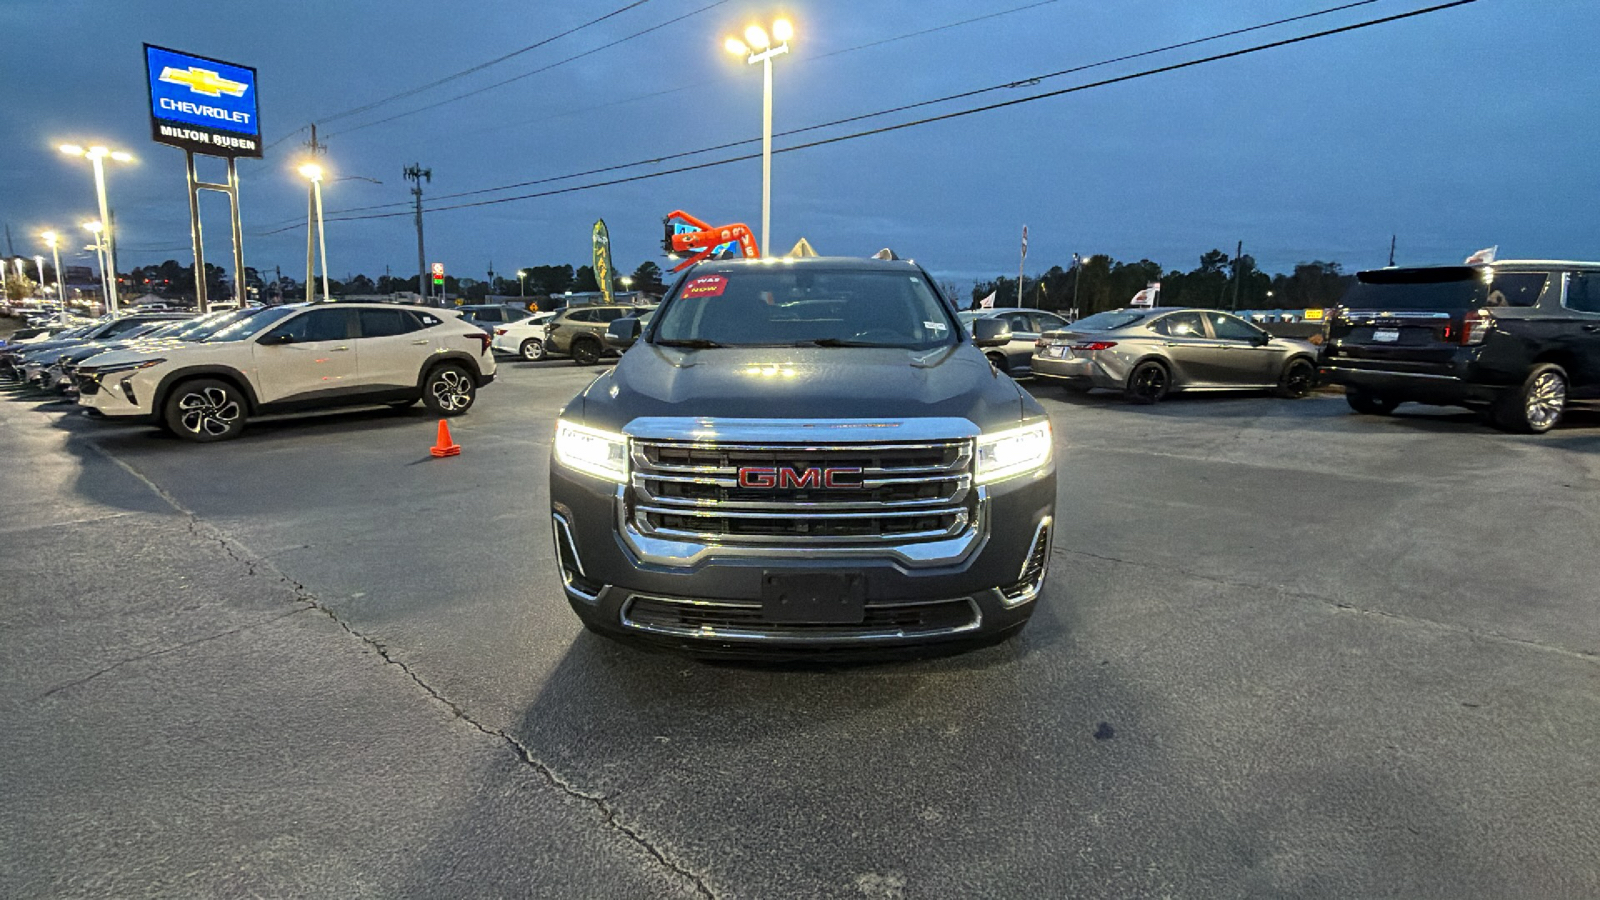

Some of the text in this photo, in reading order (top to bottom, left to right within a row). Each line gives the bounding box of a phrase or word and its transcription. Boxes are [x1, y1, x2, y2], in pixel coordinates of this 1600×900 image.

[160, 98, 250, 123] CHEVROLET
[160, 125, 209, 143] MILTON
[738, 466, 863, 489] GMC
